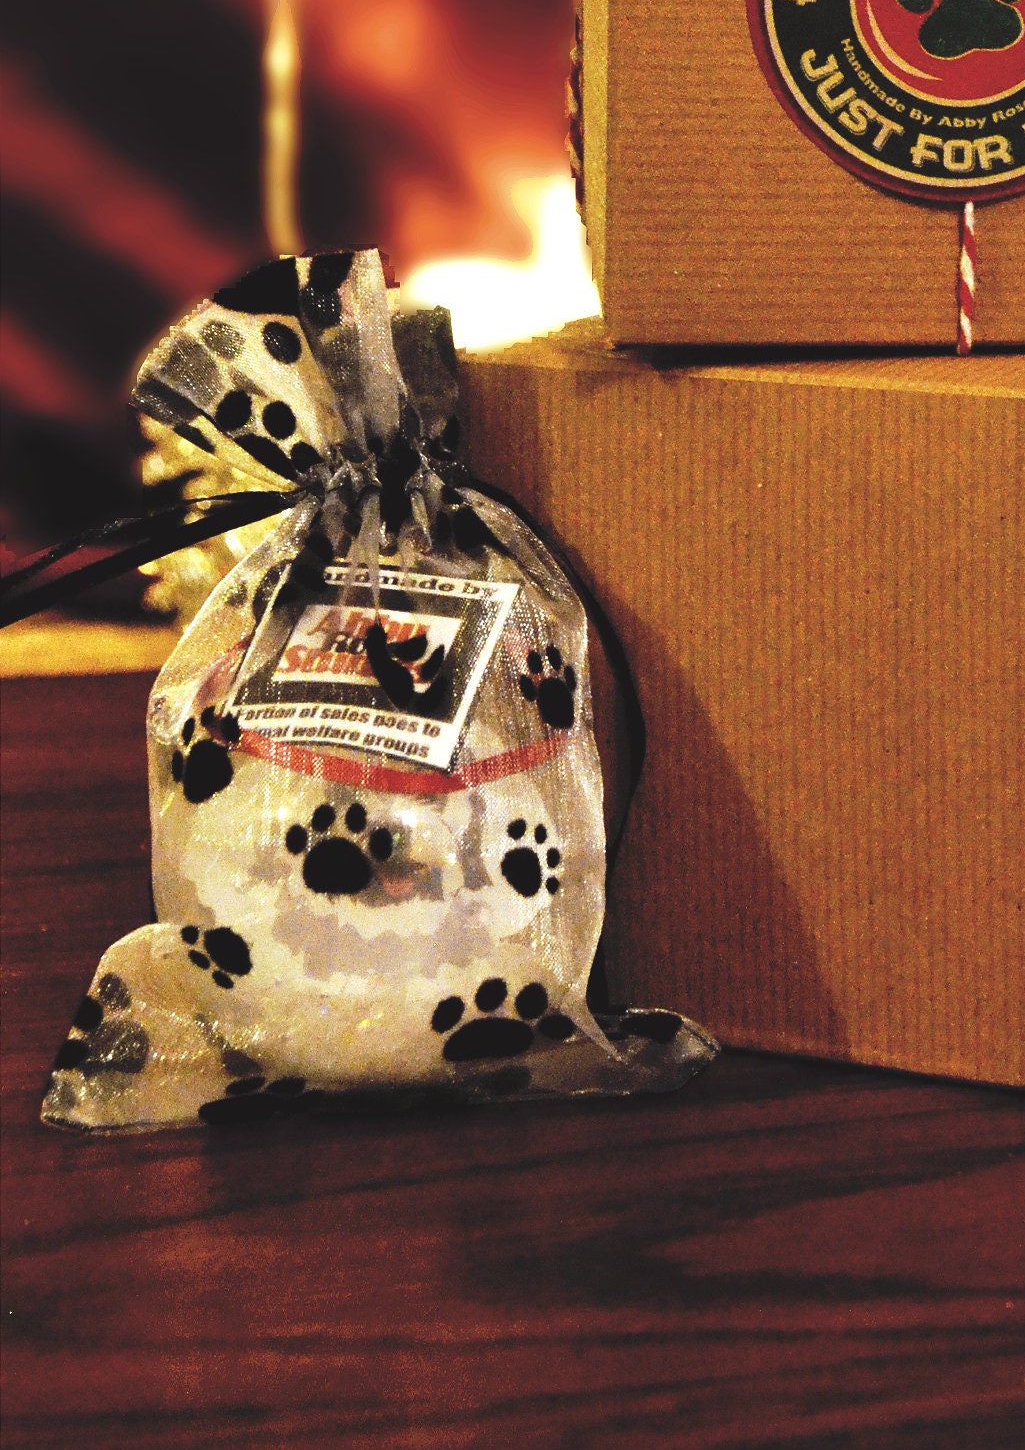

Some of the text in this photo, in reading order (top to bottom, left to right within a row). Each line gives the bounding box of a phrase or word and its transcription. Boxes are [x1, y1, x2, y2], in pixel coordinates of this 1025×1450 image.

[800, 48, 906, 151] JUST
[910, 133, 1014, 172] FOR
[840, 38, 906, 113] Handmade
[909, 108, 932, 126] By
[937, 115, 986, 129] Abby
[292, 725, 360, 741] welfare
[362, 734, 430, 758] groups
[299, 705, 318, 718] of
[320, 707, 370, 723] sales
[422, 723, 441, 738] to
